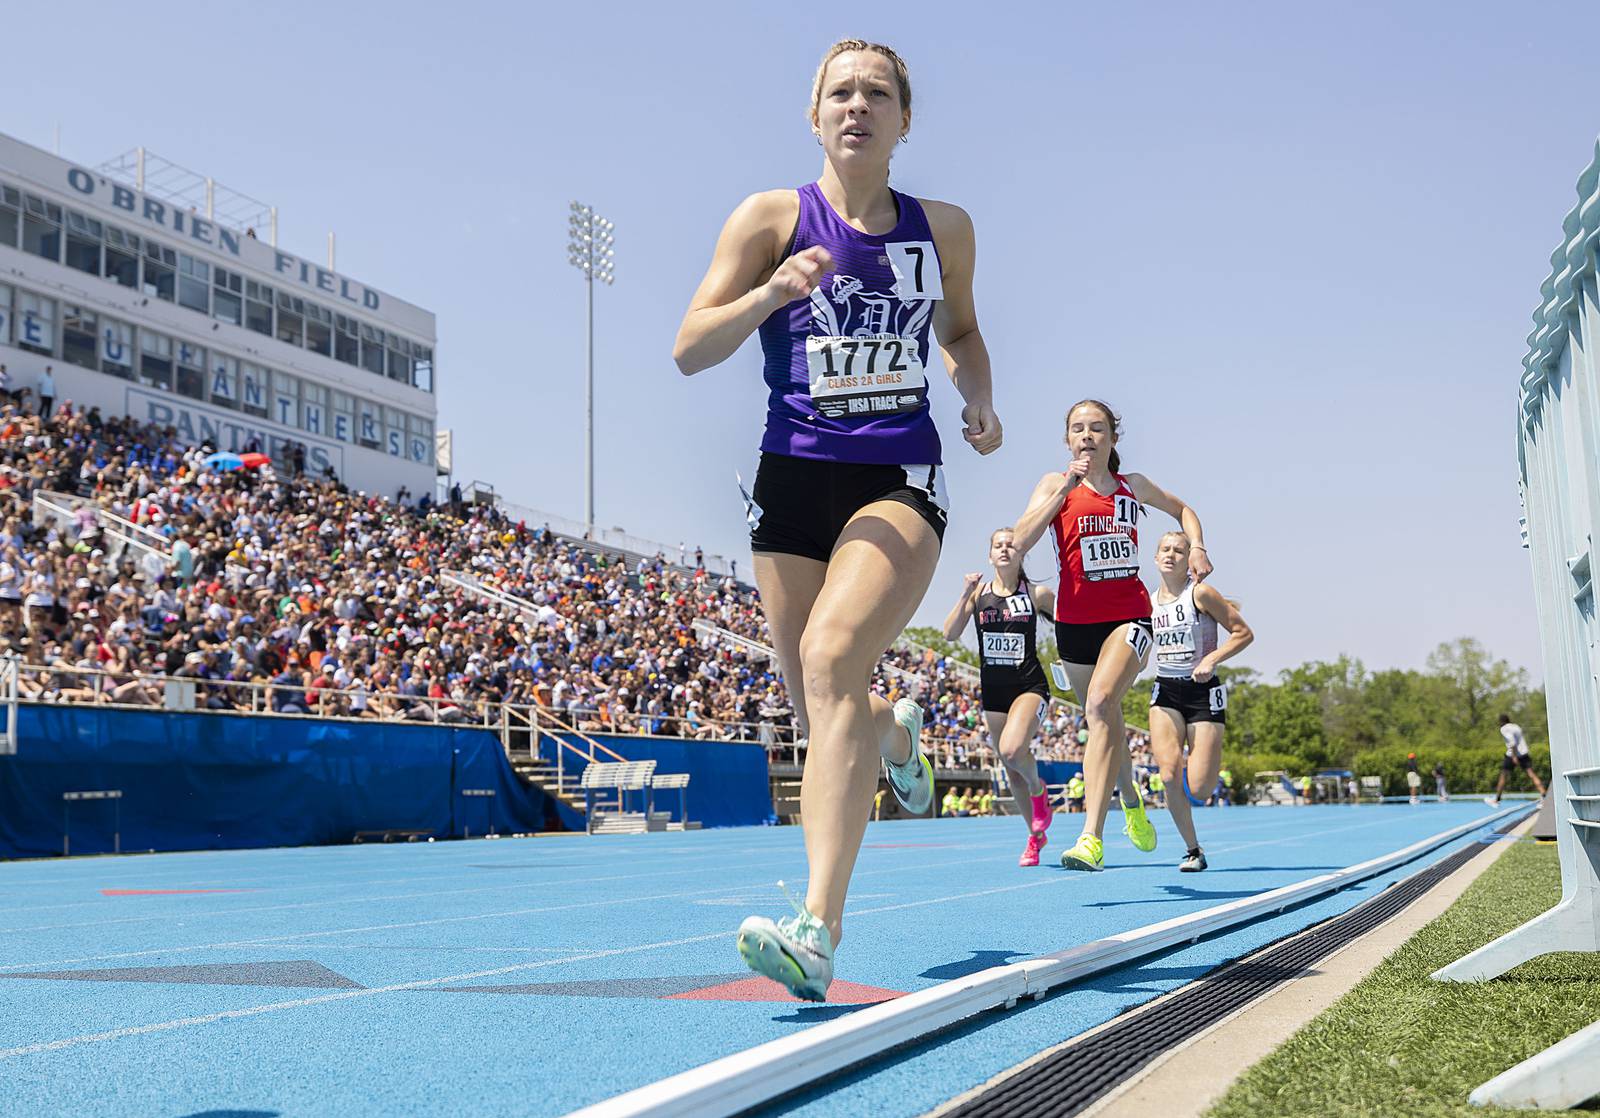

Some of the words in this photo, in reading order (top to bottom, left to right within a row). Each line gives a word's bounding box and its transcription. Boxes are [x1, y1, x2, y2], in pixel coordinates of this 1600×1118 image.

[67, 168, 240, 256] O'BRIEN
[274, 251, 380, 311] FIELD
[904, 247, 924, 293] 7
[820, 340, 908, 378] 1772
[828, 377, 859, 389] CLASS
[861, 376, 873, 386] 2A
[876, 373, 903, 385] GIRLS
[848, 397, 870, 413] IHSA
[870, 395, 899, 411] TRACK
[147, 401, 330, 474] PANTHES
[1118, 498, 1138, 526] 10
[1088, 540, 1131, 562] 1805
[1010, 596, 1031, 613] 11
[1175, 604, 1185, 621] 8
[987, 637, 1019, 652] 2032
[1129, 626, 1148, 658] 10
[1156, 631, 1186, 647] 2247
[1215, 688, 1224, 708] 8
